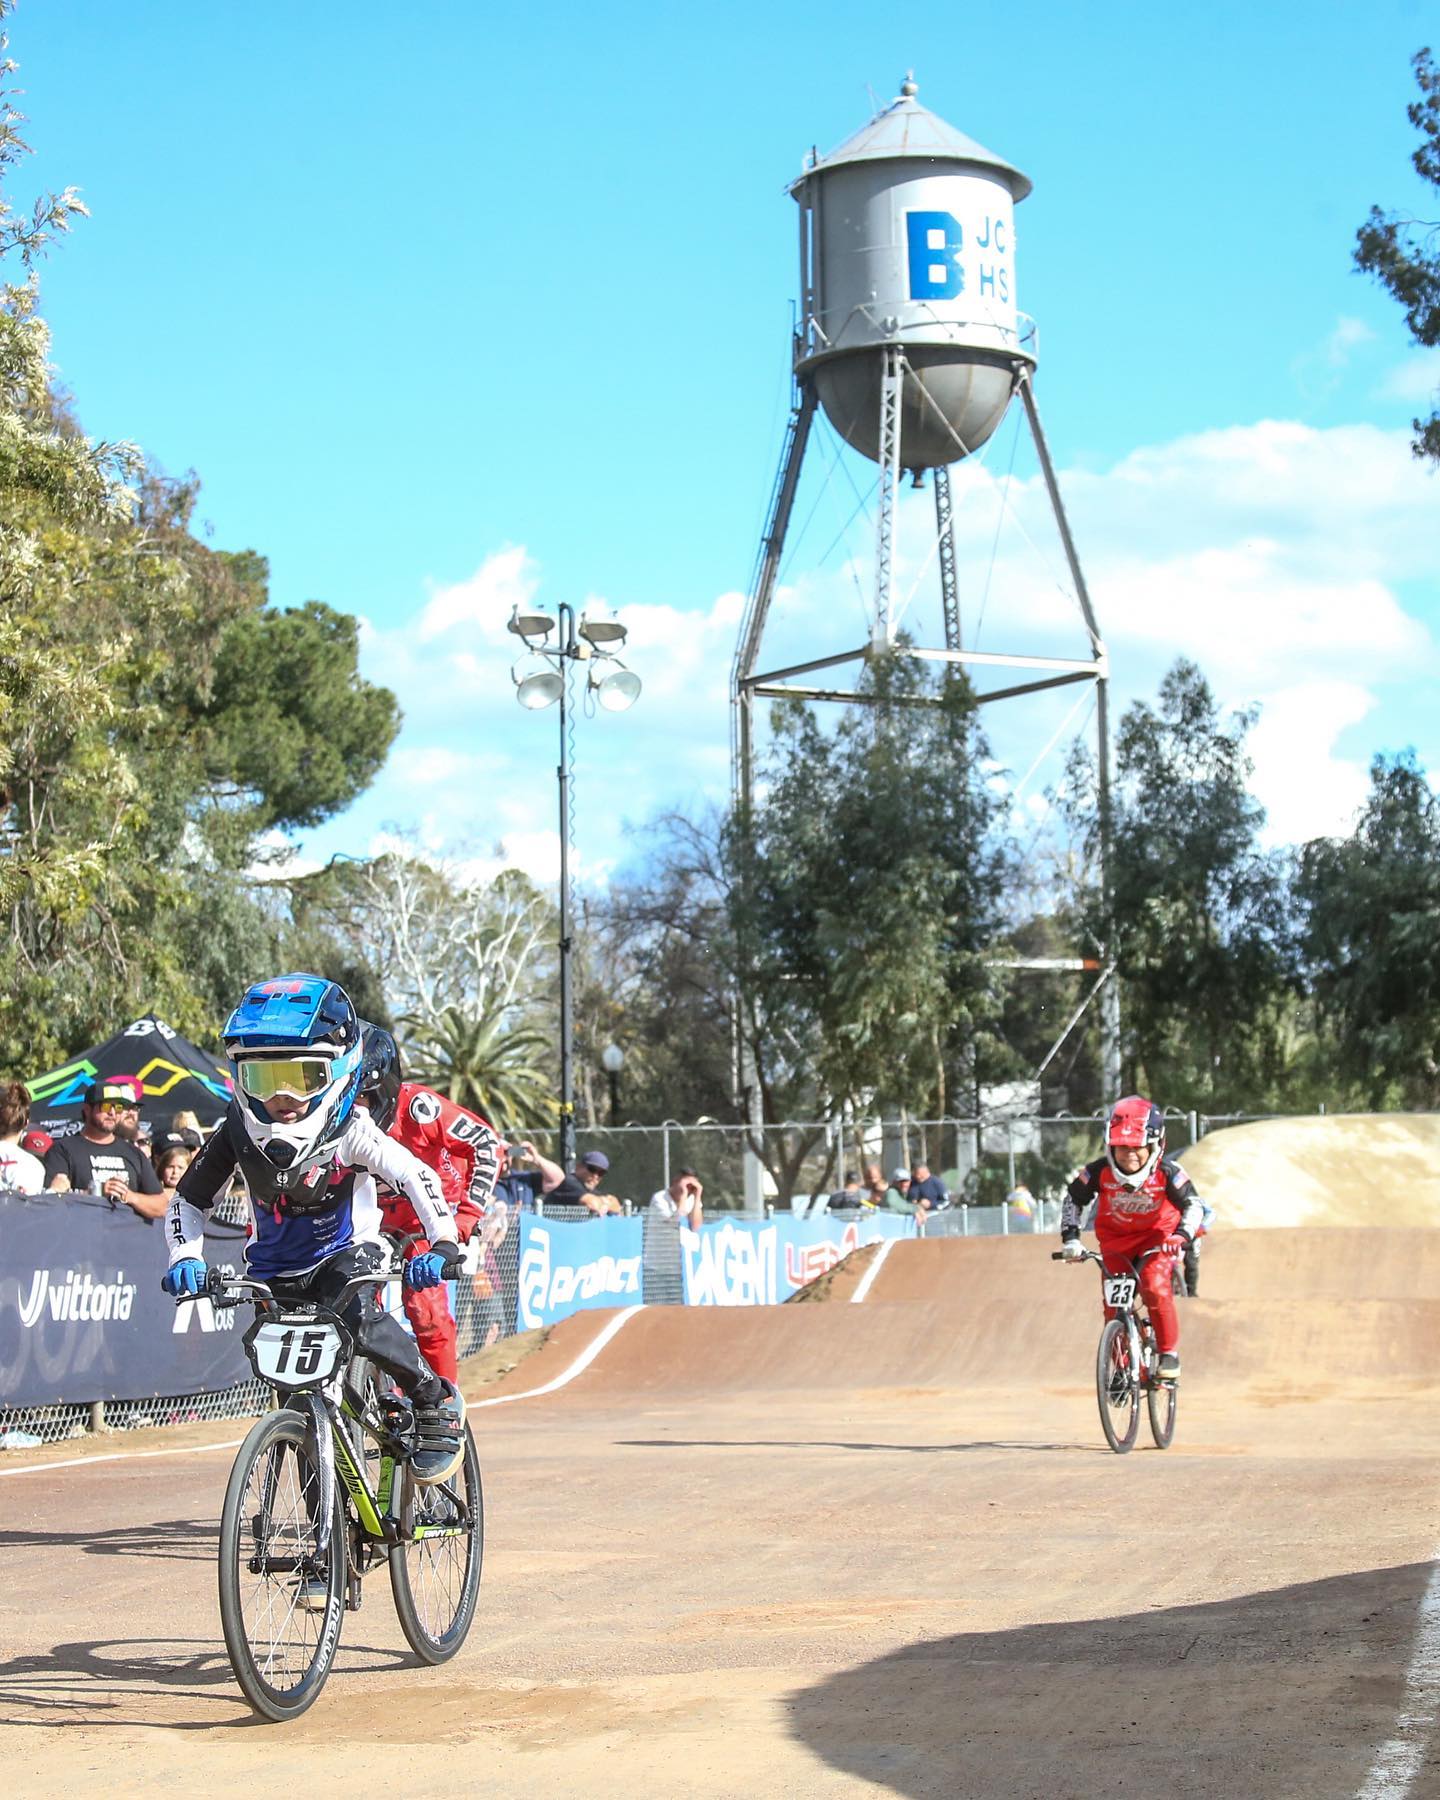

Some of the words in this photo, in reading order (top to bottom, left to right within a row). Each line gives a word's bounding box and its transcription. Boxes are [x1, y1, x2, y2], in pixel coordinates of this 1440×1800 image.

[906, 211, 965, 301] B
[980, 263, 1009, 304] HS
[48, 1270, 134, 1321] vittoria
[1110, 1284, 1132, 1304] 23
[279, 1314, 318, 1322] TANGENT
[275, 1330, 327, 1375] 15
